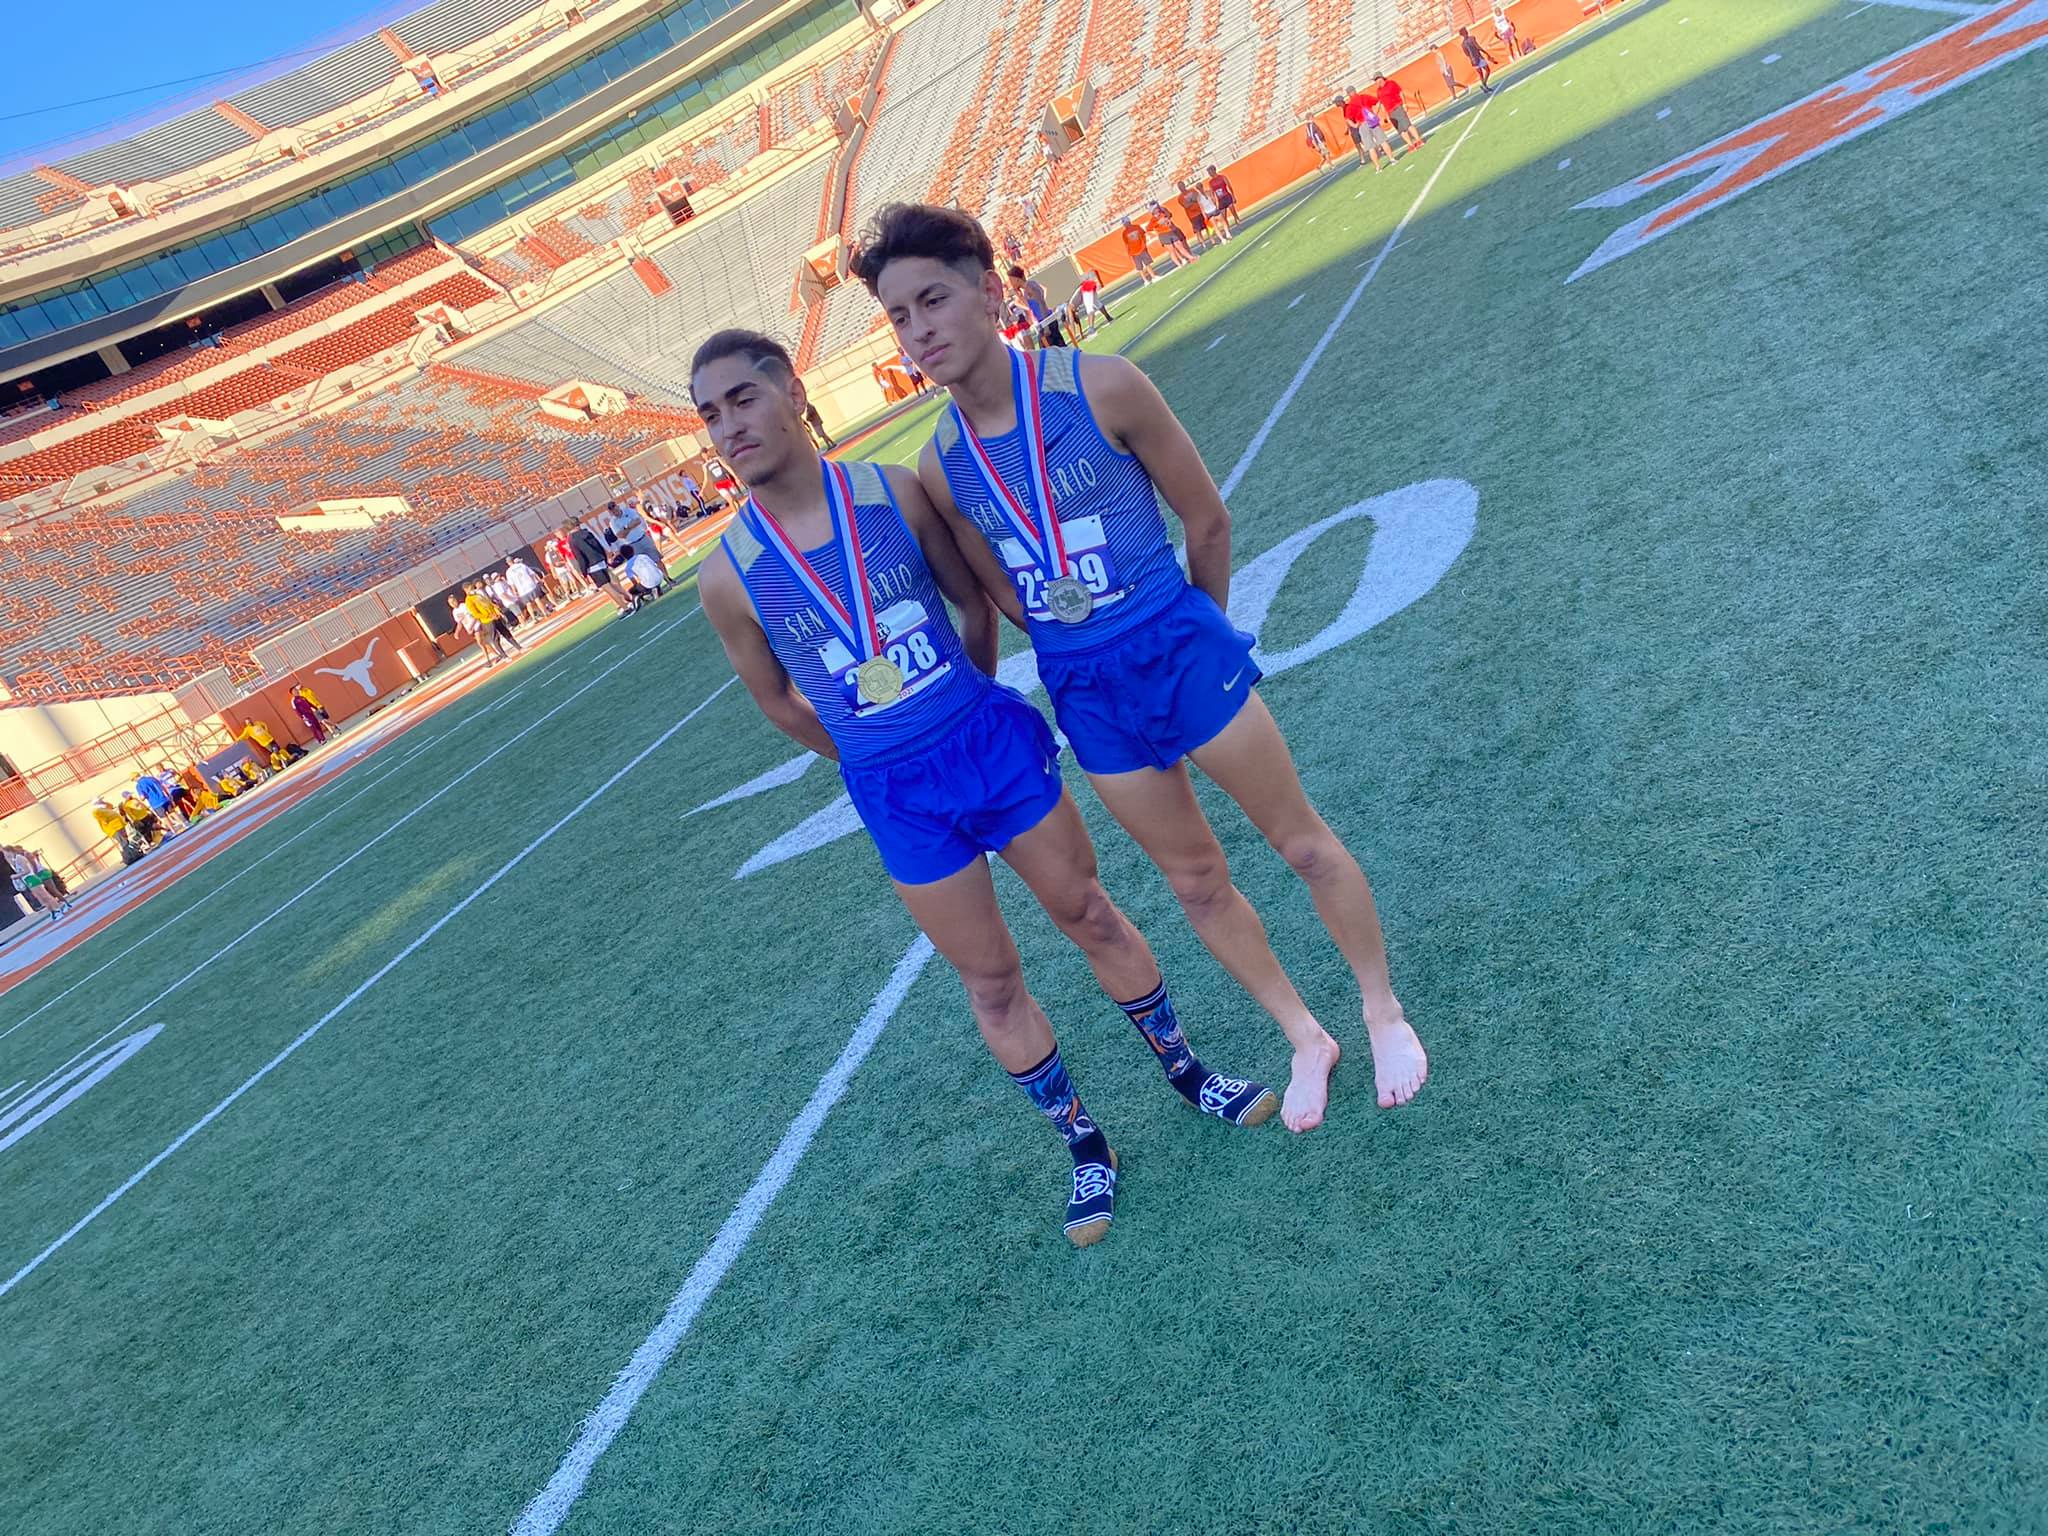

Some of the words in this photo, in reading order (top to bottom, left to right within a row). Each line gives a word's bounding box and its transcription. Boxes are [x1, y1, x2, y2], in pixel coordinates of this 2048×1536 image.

[1016, 552, 1109, 609] 239
[783, 605, 827, 643] SAN
[844, 630, 938, 706] 228
[899, 687, 915, 699] 2021
